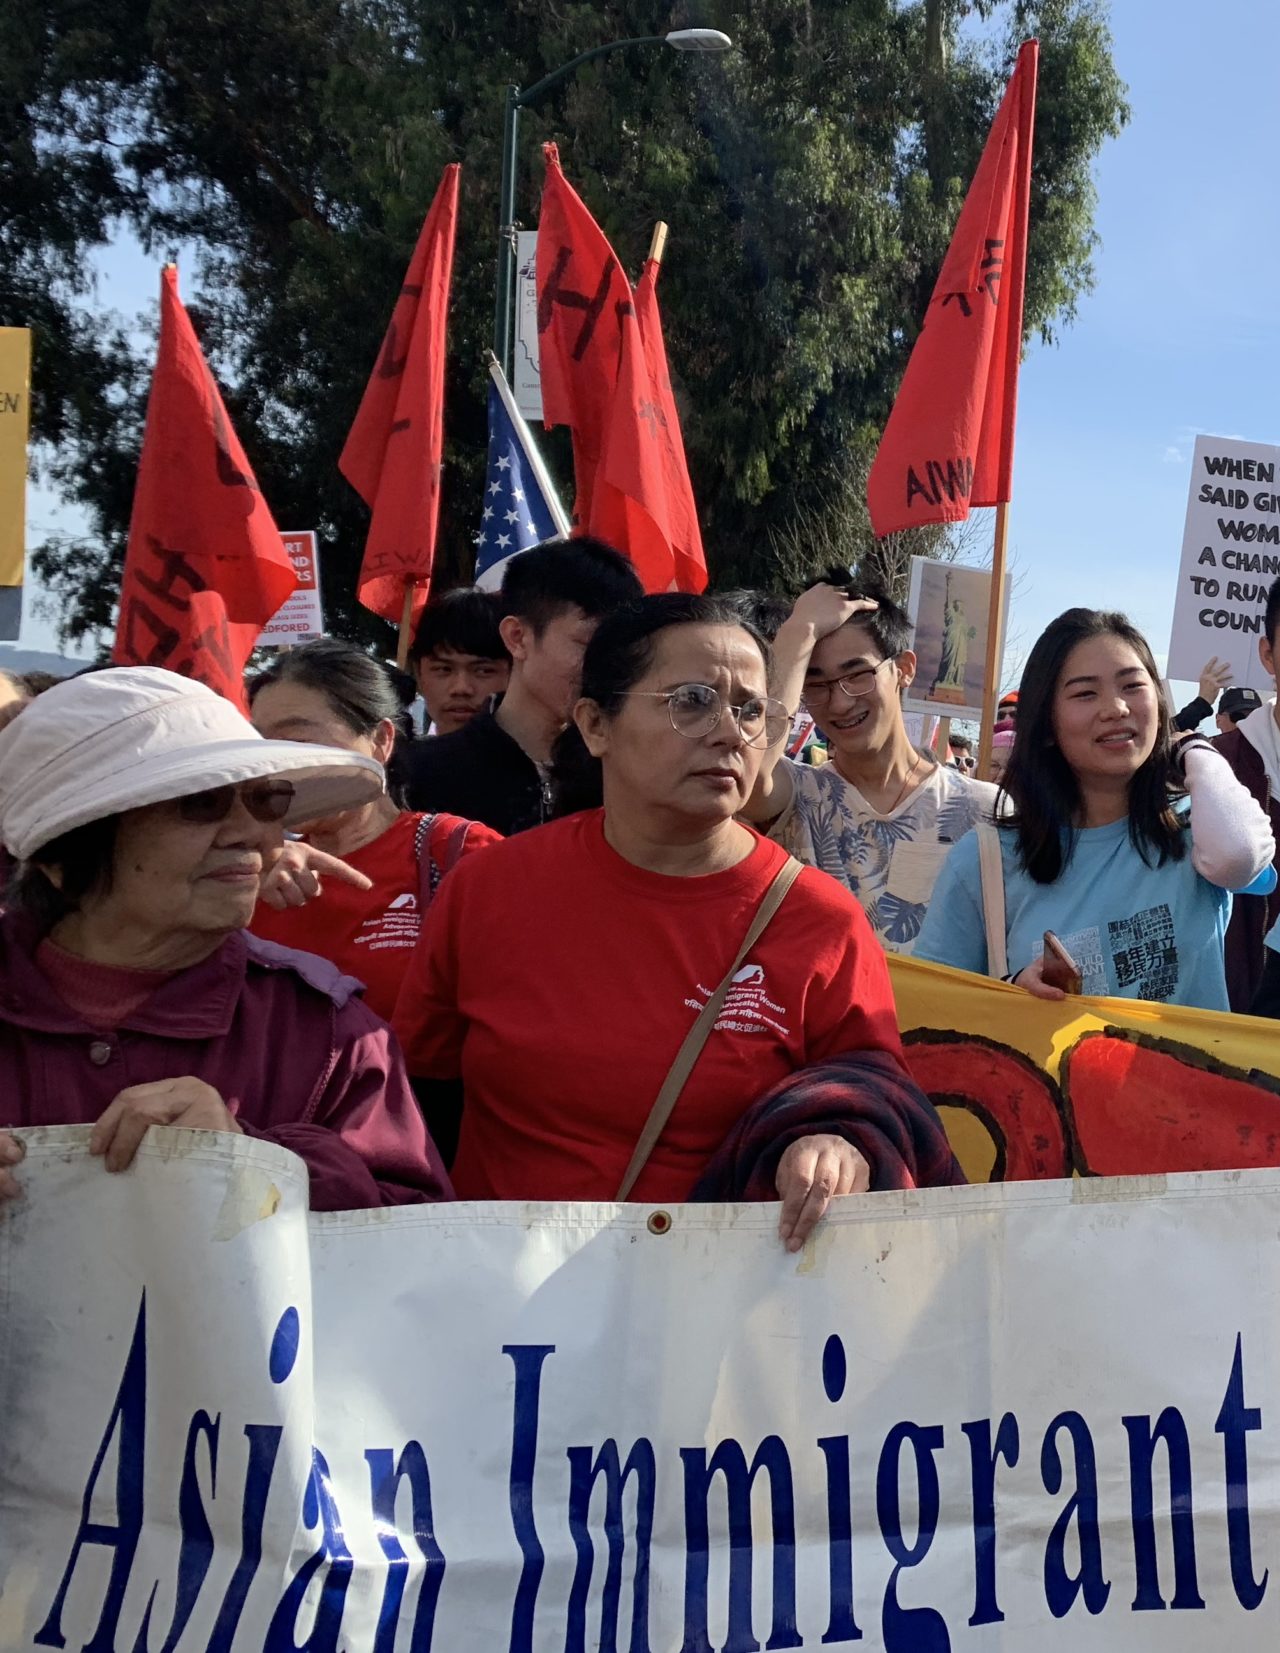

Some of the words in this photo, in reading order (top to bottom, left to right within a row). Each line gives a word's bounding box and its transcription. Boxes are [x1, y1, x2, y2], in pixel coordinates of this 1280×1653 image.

[1203, 456, 1275, 483] WHEN
[1198, 484, 1249, 510] SAID
[1198, 546, 1217, 567] A
[1190, 575, 1220, 597] TO
[1198, 608, 1266, 634] COUN
[34, 1285, 447, 1653] Asian
[502, 1332, 1269, 1653] Immigrant
